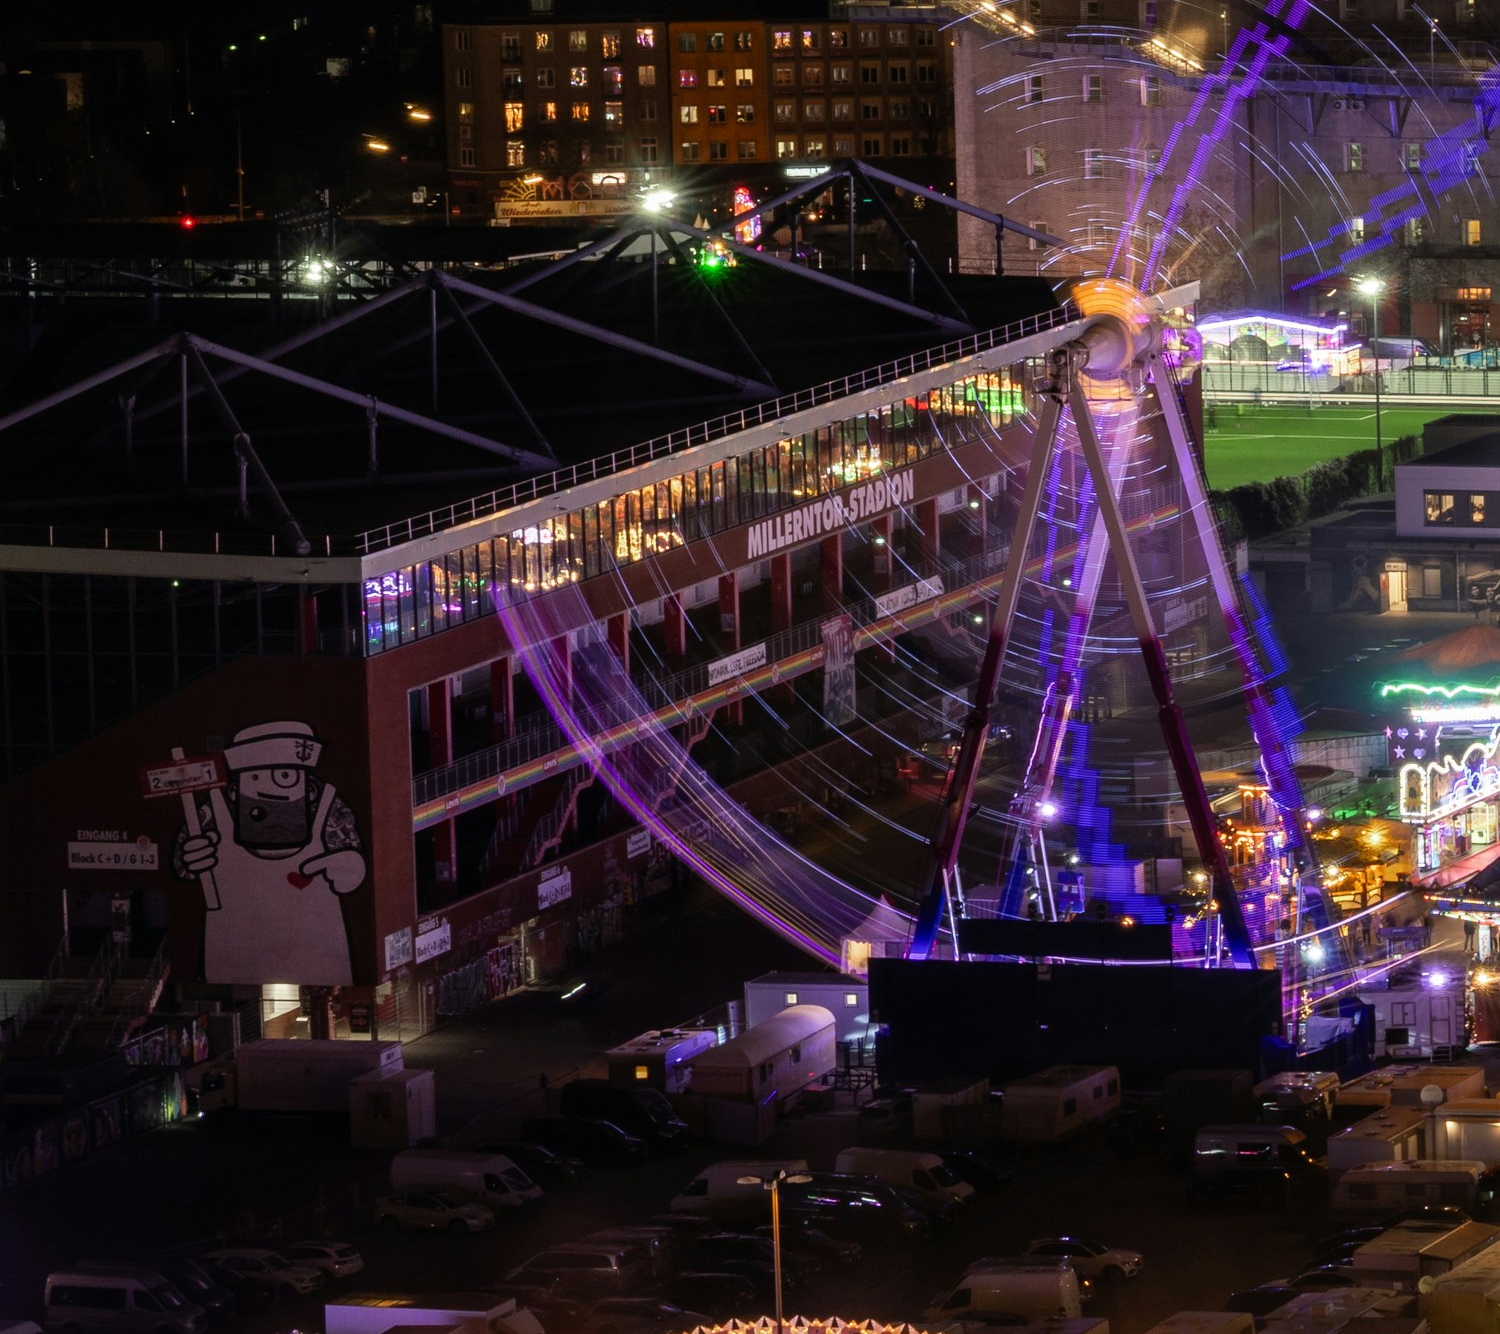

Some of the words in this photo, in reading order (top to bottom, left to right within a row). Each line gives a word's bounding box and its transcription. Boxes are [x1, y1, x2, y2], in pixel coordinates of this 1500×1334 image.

[747, 468, 916, 560] MILLERNTOR-STADION
[77, 828, 119, 842] EINGANG
[121, 830, 129, 842] 4
[71, 851, 96, 867] Block
[141, 853, 157, 867] 1-3
